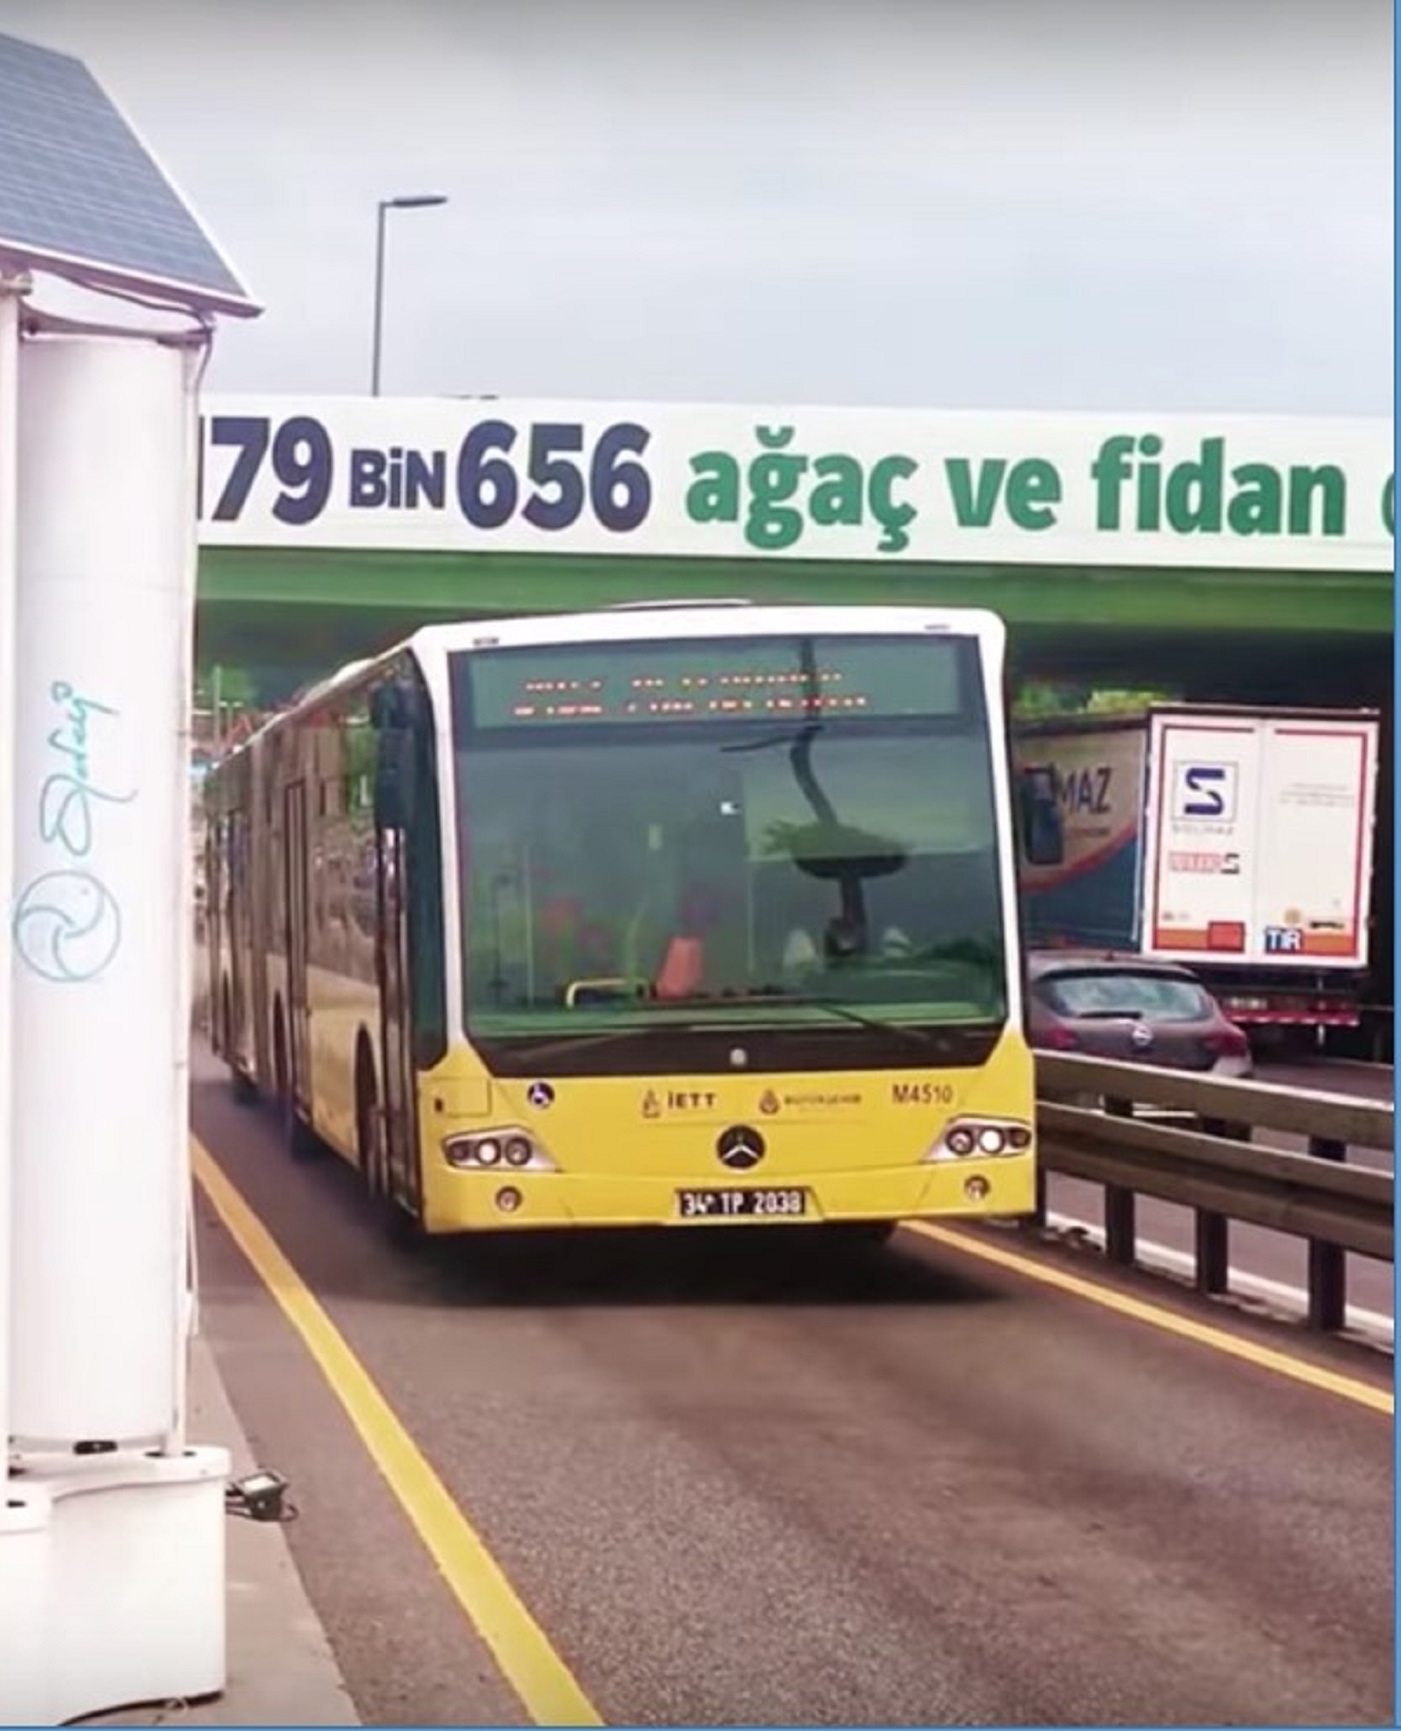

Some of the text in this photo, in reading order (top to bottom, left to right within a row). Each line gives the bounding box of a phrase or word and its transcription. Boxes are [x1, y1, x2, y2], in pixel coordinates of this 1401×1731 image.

[196, 416, 333, 526] 79
[457, 419, 653, 532] 656
[686, 425, 919, 552] ağaç
[944, 457, 1062, 531] ve
[1090, 434, 1347, 537] fidan
[892, 1084, 953, 1104] M4510
[721, 1191, 744, 1214] TP
